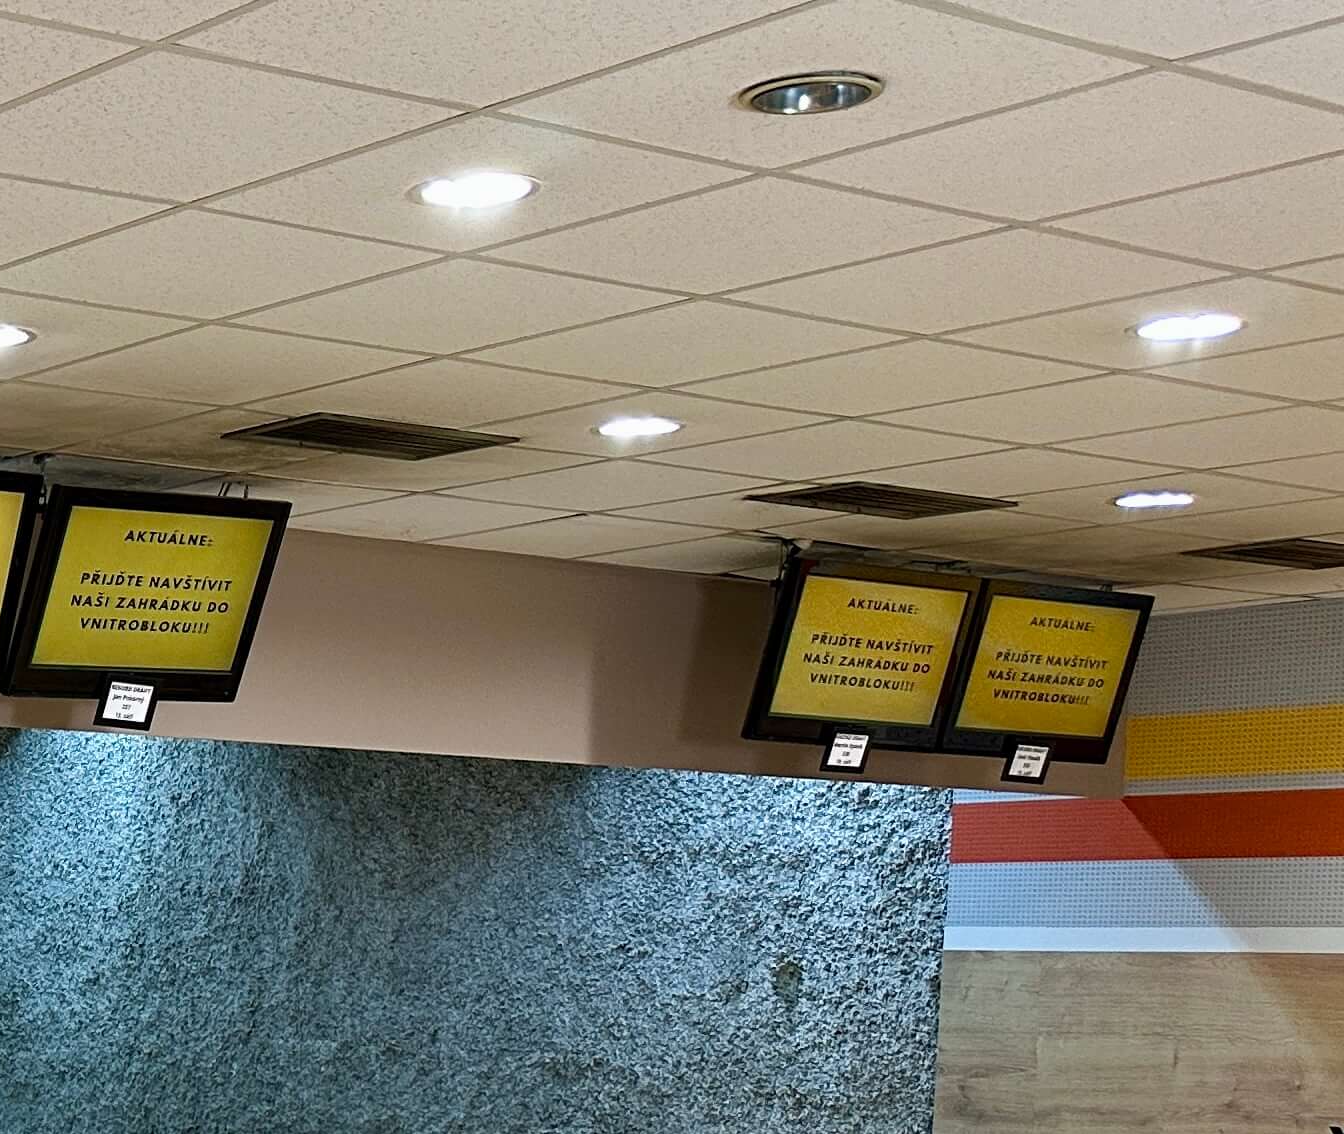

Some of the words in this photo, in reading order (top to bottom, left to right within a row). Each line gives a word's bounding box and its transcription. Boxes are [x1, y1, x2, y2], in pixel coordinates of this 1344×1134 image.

[124, 529, 214, 547] AKTUÁLNE:
[80, 570, 143, 588] PŘIJĎTE
[148, 572, 233, 592] NAVŠTÍVIT
[71, 592, 109, 609] NAŠI
[115, 593, 201, 613] ZAHRÁDKU
[207, 601, 230, 613] DO
[80, 617, 209, 634] VNITROBLOKU!!!
[803, 652, 834, 665] NAŠI
[912, 662, 931, 674] DO
[1088, 677, 1105, 688] DO
